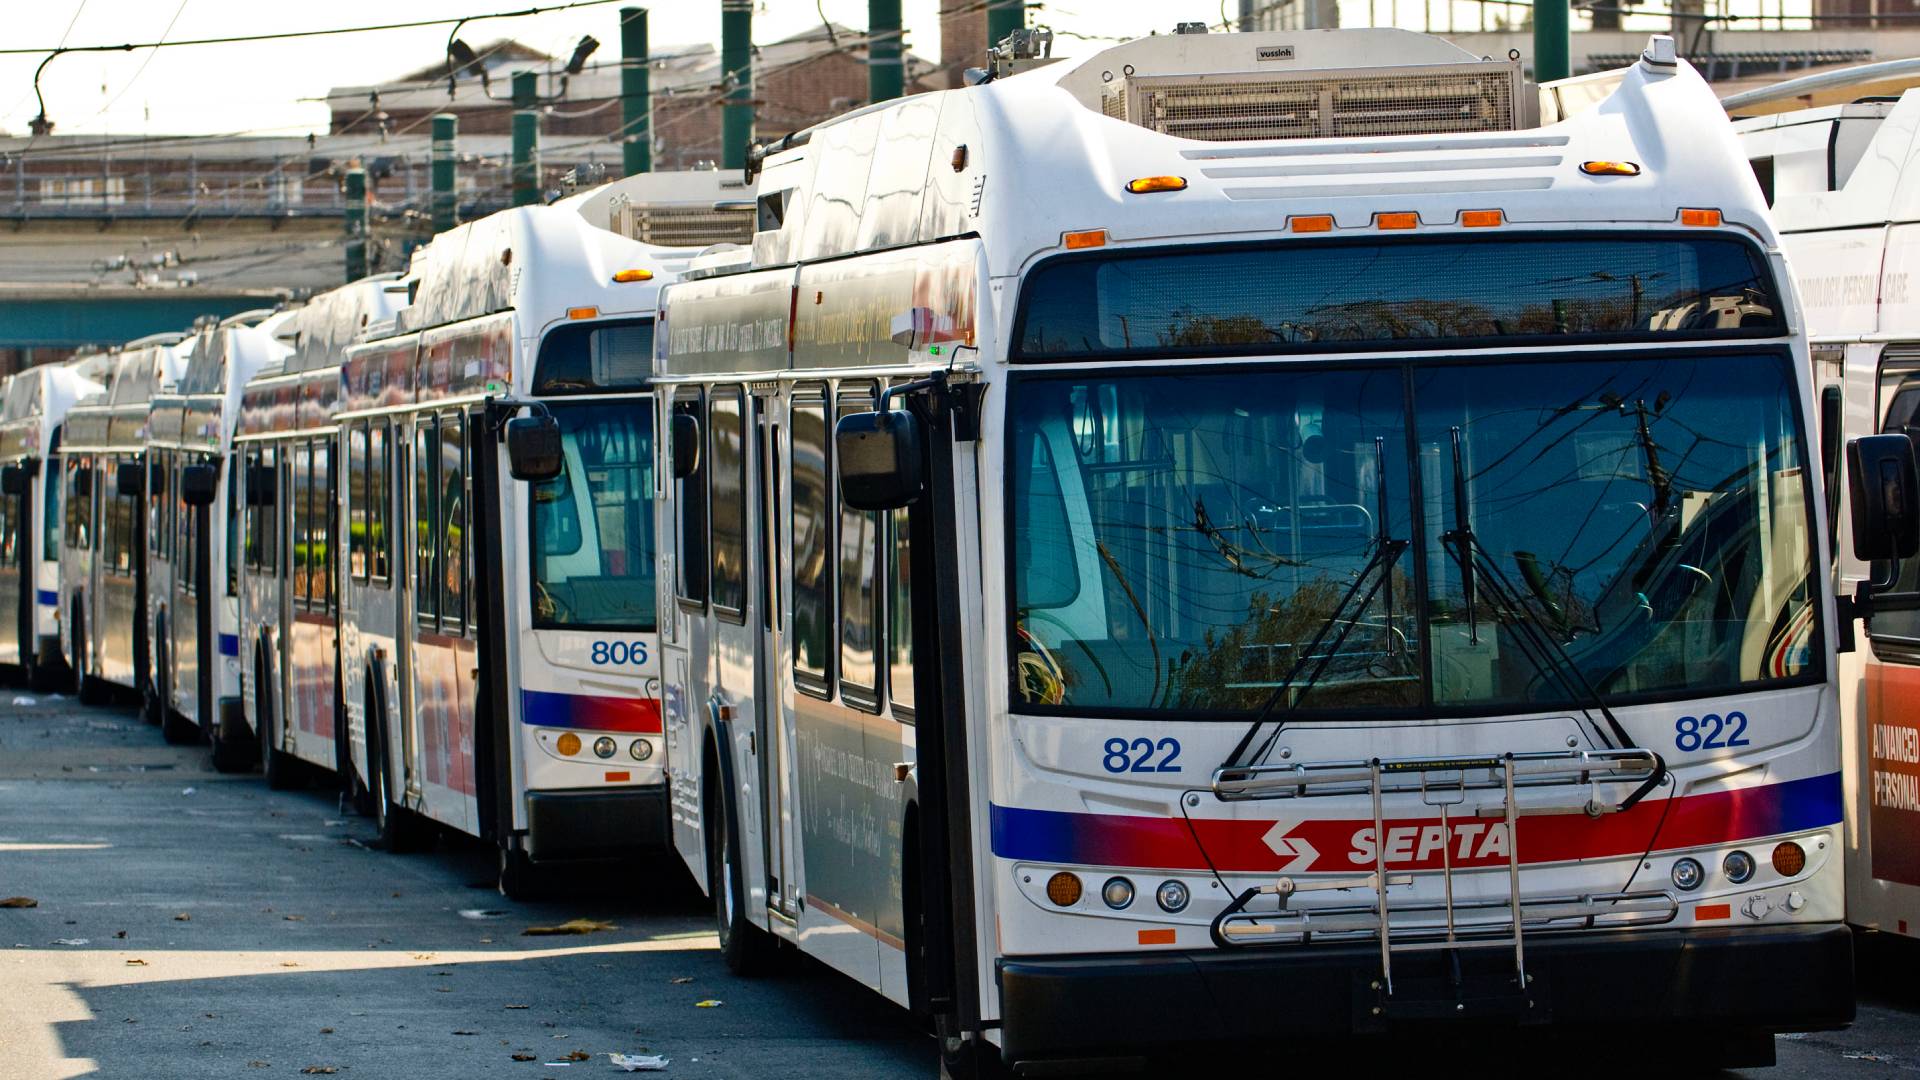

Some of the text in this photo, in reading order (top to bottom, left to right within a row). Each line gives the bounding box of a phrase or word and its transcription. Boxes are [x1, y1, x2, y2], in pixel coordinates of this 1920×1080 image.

[591, 640, 648, 665] 806
[1675, 711, 1750, 752] 822
[1873, 723, 1919, 763] ADVANCED
[1102, 737, 1182, 773] 822
[1874, 770, 1920, 812] PERSONAL
[1347, 822, 1512, 864] SEPTA
